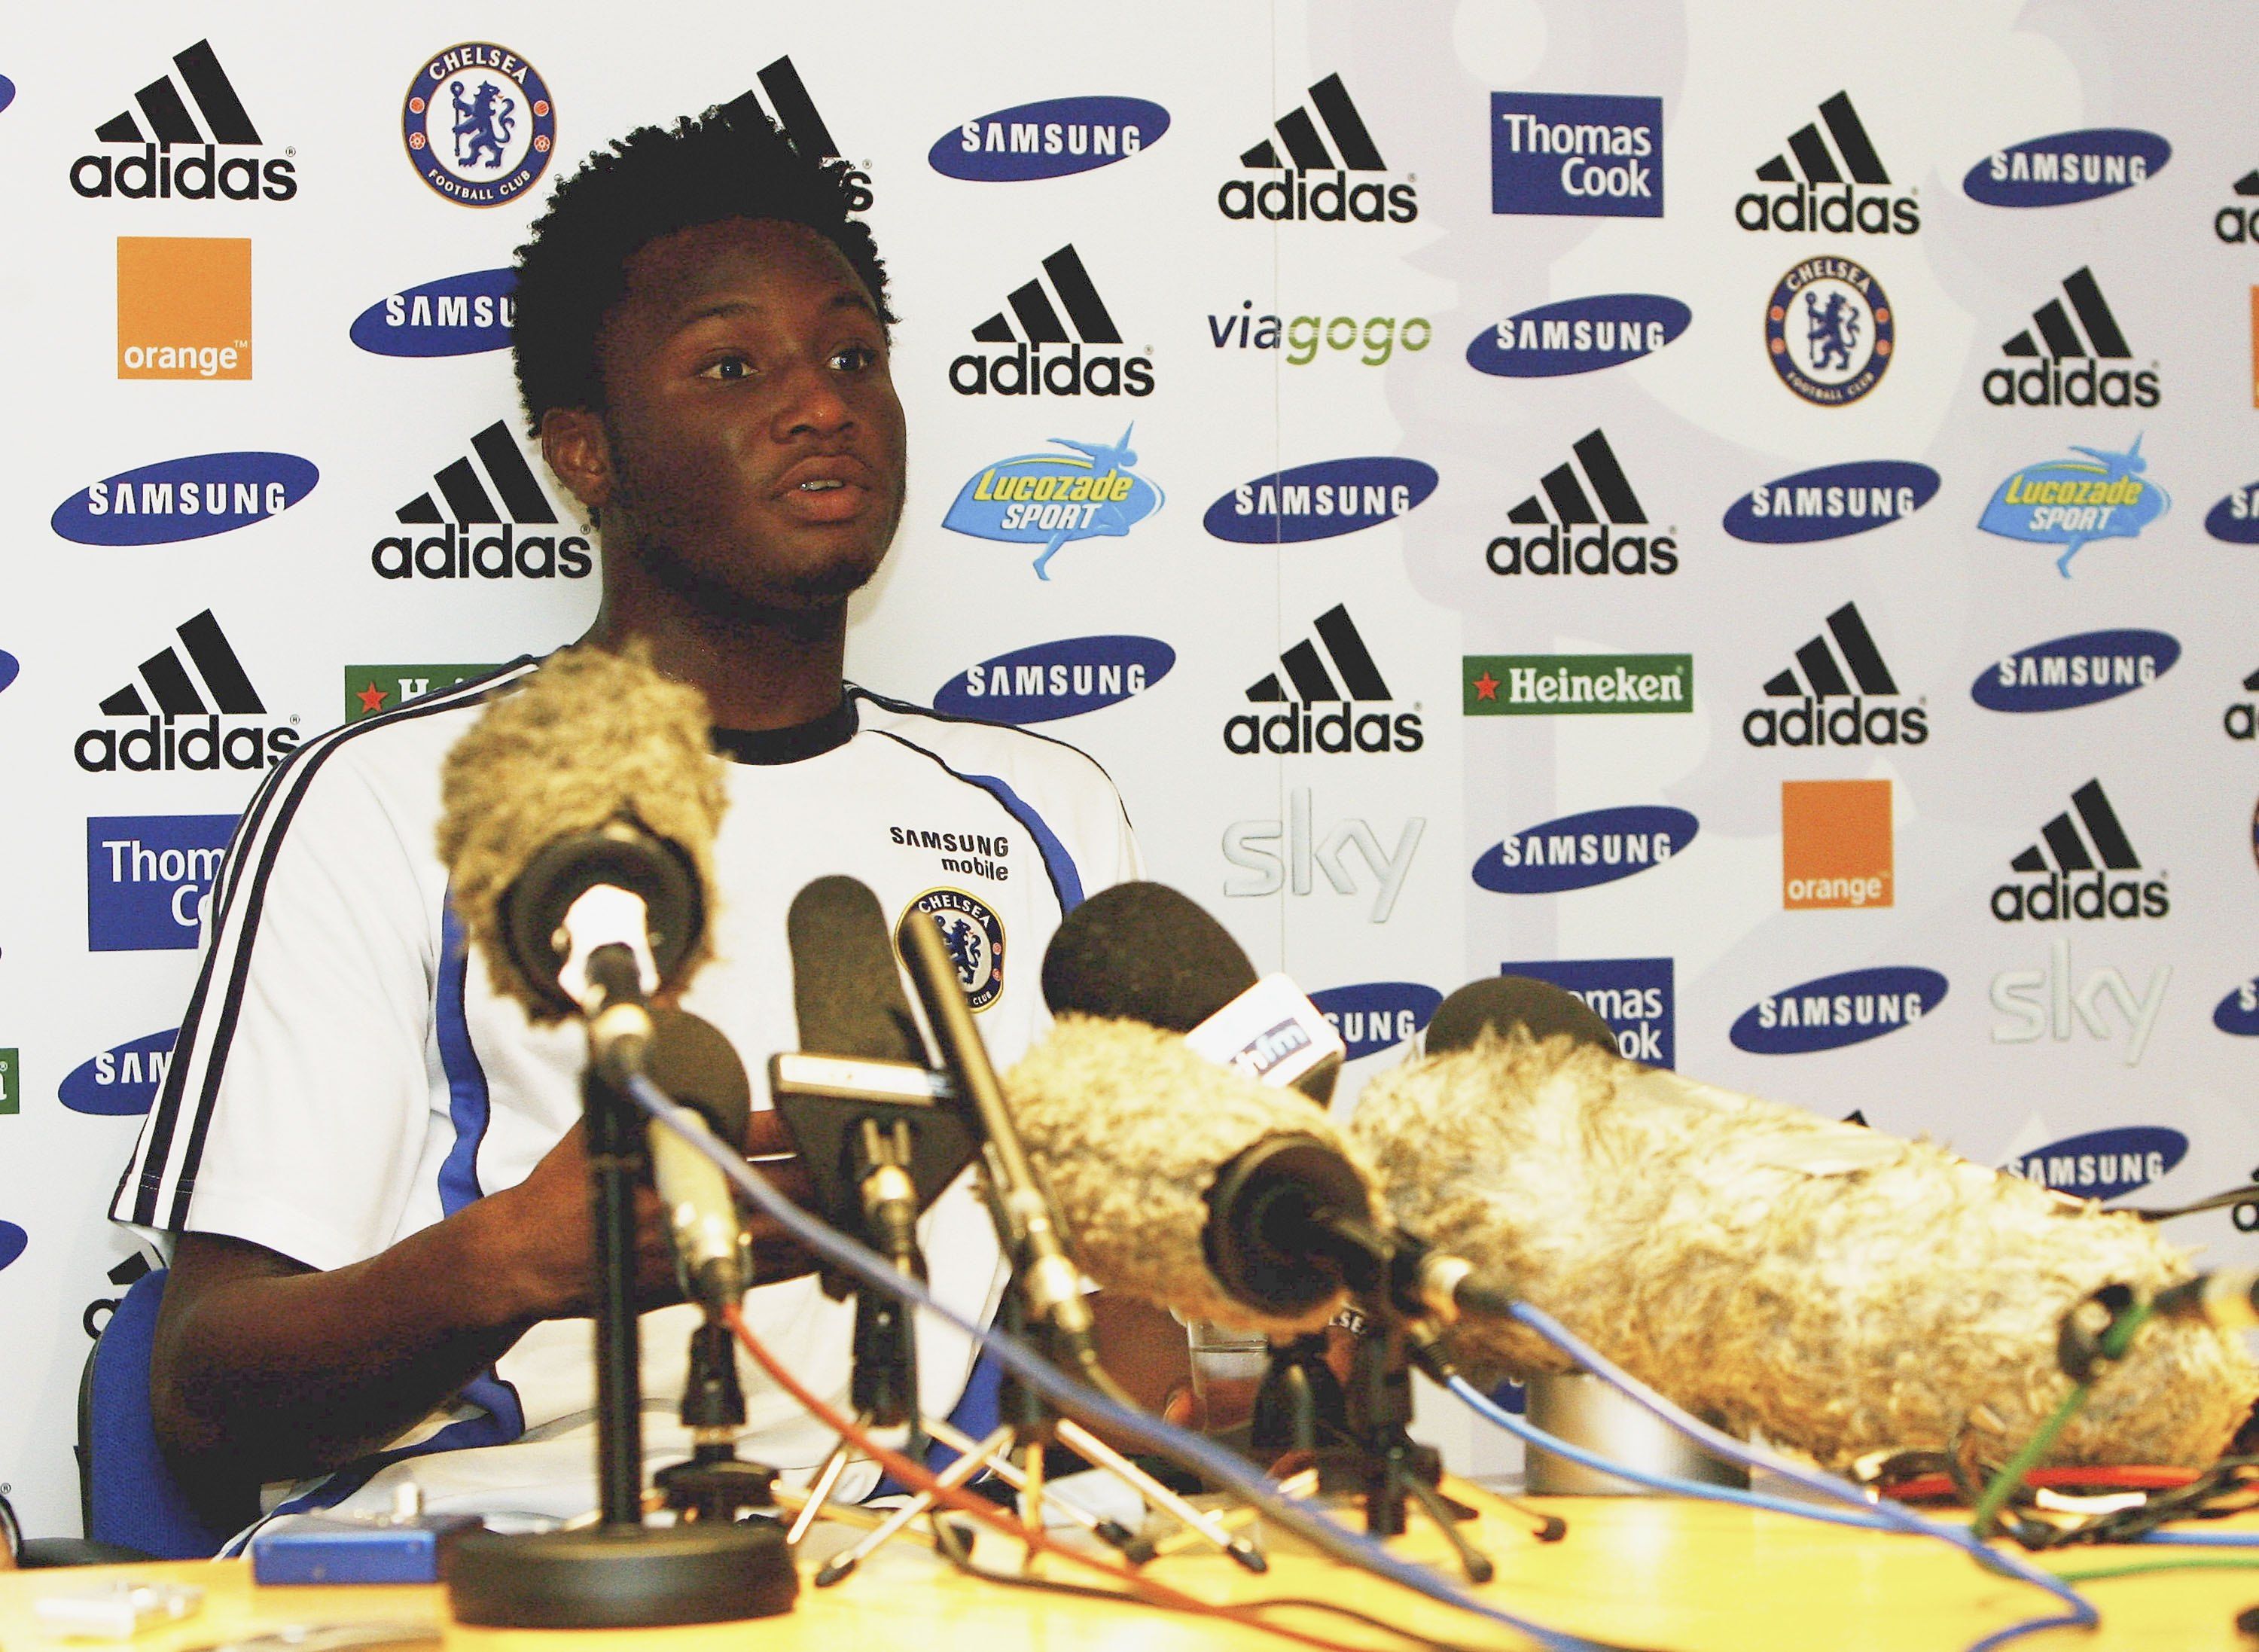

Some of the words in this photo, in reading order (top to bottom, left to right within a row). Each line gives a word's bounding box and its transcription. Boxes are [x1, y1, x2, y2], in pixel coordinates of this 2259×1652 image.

[429, 47, 528, 84] CHELSEA
[962, 121, 1141, 156] SAMSUNG
[1503, 114, 1651, 157] Thomas
[69, 143, 297, 201] adidas
[428, 169, 494, 200] FOOTBALL
[499, 169, 531, 196] CLUB
[1561, 158, 1651, 198] Cook
[1990, 151, 2147, 185] SAMSUNG
[1218, 169, 1419, 223] adidas
[1735, 183, 1921, 235] adidas
[1786, 259, 1871, 293] CHELSEA
[386, 294, 515, 328] SAMSU
[1208, 301, 1432, 366] viagogo
[1497, 320, 1666, 352] SAMSUNG
[123, 345, 238, 376] orange
[949, 343, 1155, 397] adidas
[1983, 358, 2161, 408] adidas
[87, 481, 286, 517] SAMSUNG
[974, 469, 1134, 503] Lucozade
[1235, 484, 1410, 517] SAMSUNG
[1751, 486, 1915, 517] SAMSUNG
[2005, 474, 2144, 507] Lucozade
[1001, 502, 1102, 530] SPORT
[2029, 505, 2115, 532] SPORT
[371, 523, 593, 580] adidas
[1486, 525, 1679, 576] adidas
[966, 663, 1145, 697] SAMSUNG
[1509, 667, 1684, 705] Heineken
[1998, 656, 2156, 687] SAMSUNG
[1224, 702, 1425, 754] adidas
[1742, 696, 1929, 747] adidas
[74, 715, 300, 772] adidas
[890, 827, 1009, 858] SAMSUNG
[1222, 788, 1426, 924] sky
[1503, 834, 1672, 867] SAMSUNG
[102, 840, 225, 882] Thom
[941, 857, 1009, 881] mobile
[1788, 876, 1882, 905] orange
[1991, 870, 2169, 922] adidas
[918, 894, 992, 929] CHELSEA
[1566, 987, 1663, 1020] mas
[1759, 994, 1922, 1029] SAMSUNG
[1990, 937, 2174, 1068] sky
[1322, 1009, 1417, 1044] SUNG
